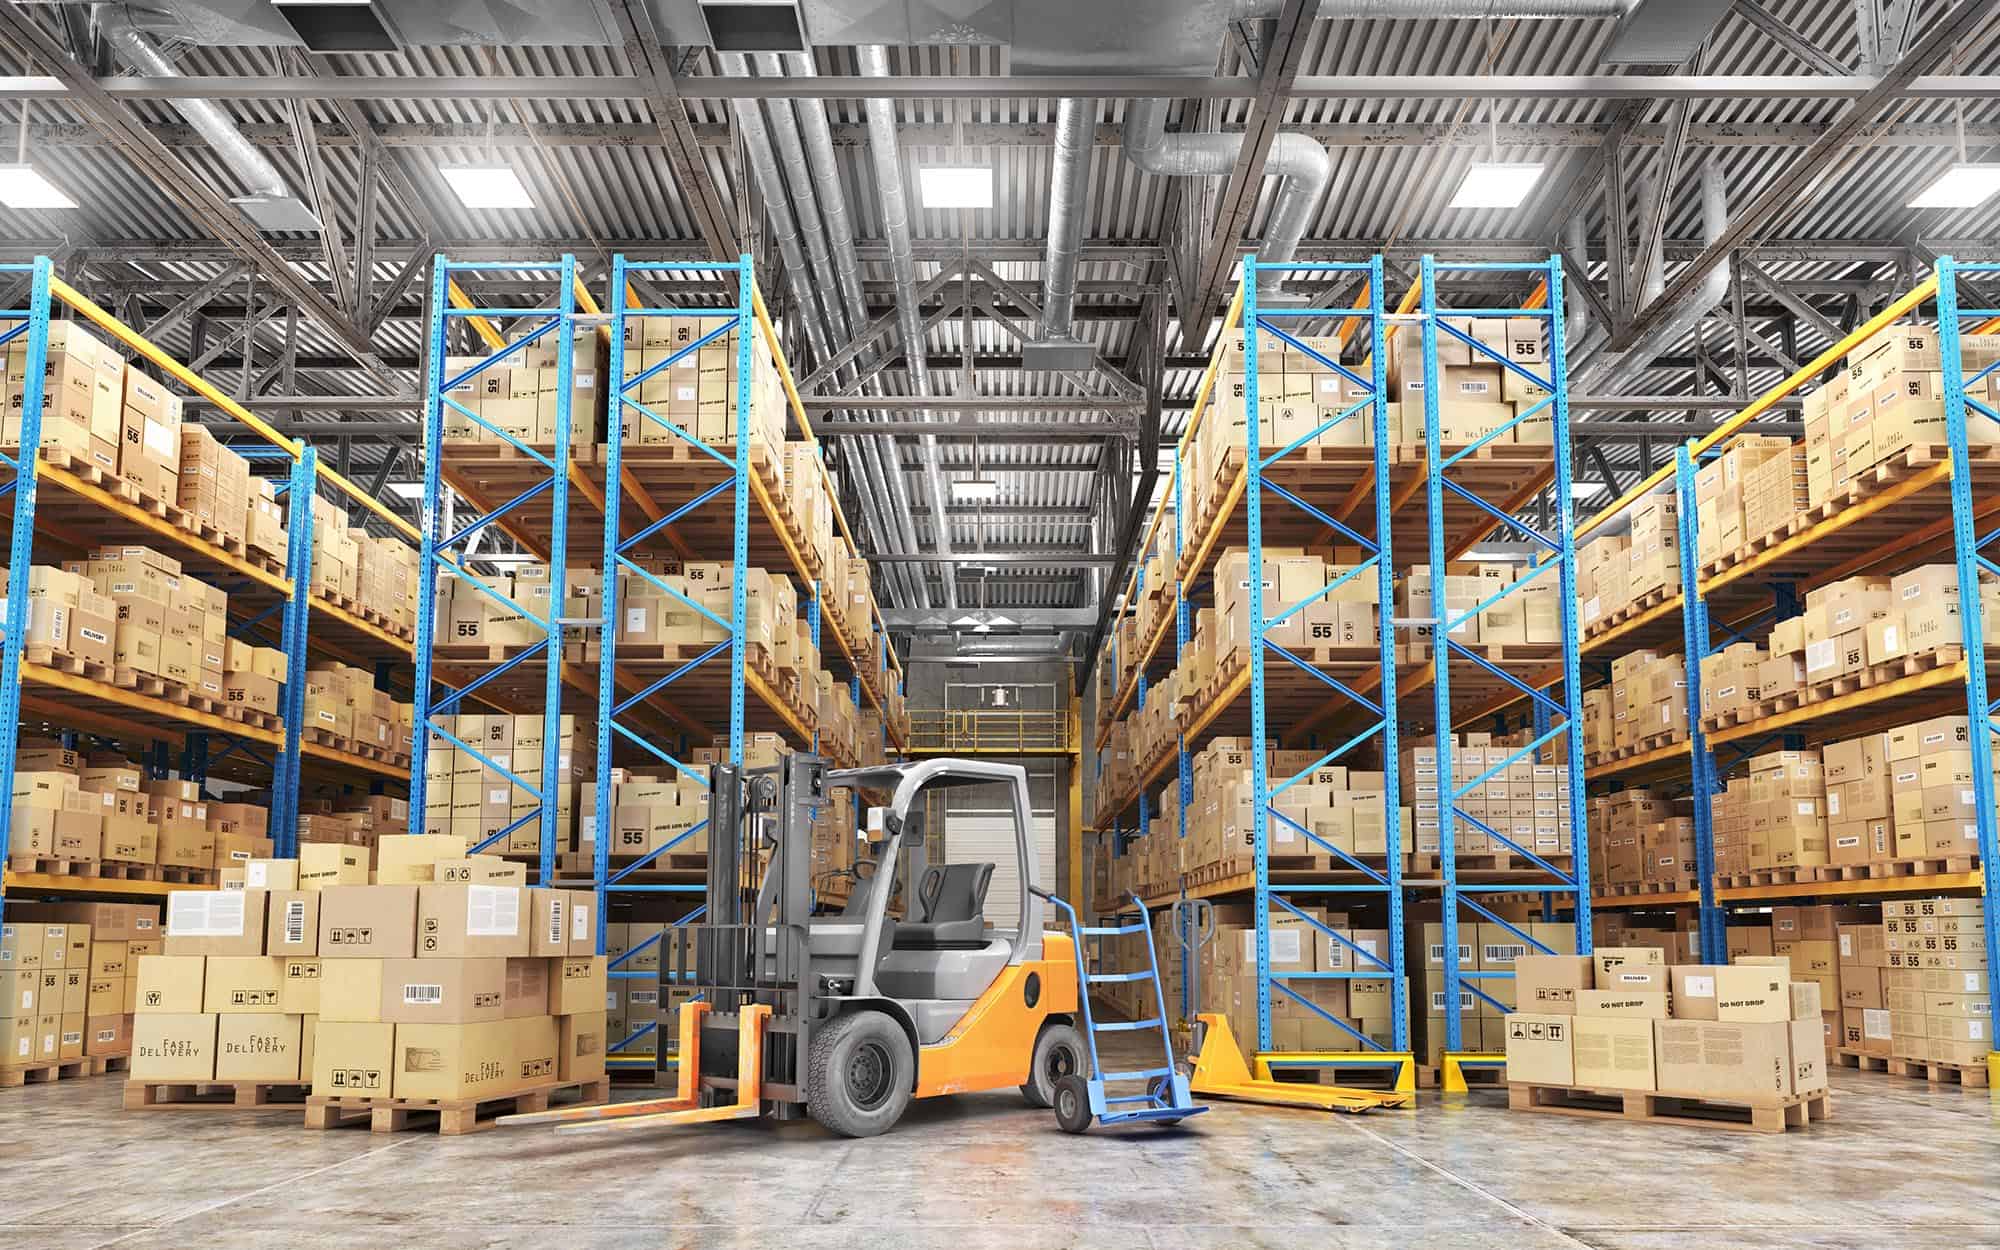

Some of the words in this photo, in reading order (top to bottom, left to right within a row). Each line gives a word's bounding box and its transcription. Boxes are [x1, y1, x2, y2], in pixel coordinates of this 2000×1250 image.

[1516, 343, 1535, 355] 55
[1909, 340, 1923, 349] 55
[1851, 368, 1863, 380] 55
[488, 379, 497, 393] 55
[1234, 384, 1243, 397] 55
[1909, 381, 1918, 396] 55
[127, 429, 139, 444] 55
[690, 571, 704, 580] 55
[458, 624, 478, 636] 55
[1312, 626, 1332, 638] 55
[83, 630, 104, 642] DELIVERY
[1848, 652, 1859, 664] 55
[228, 691, 244, 701] 55
[491, 725, 501, 739] 55
[1956, 727, 1965, 741] 55
[63, 754, 74, 765] 55
[1228, 755, 1242, 764] 55
[1319, 774, 1333, 783] 55
[623, 832, 643, 845] 55
[1904, 906, 1915, 915] 55
[1922, 904, 1934, 915] 55
[1888, 923, 1898, 932] 55
[1905, 922, 1917, 933] 55
[1926, 940, 1937, 949] 55
[1945, 939, 1957, 950] 55
[1891, 956, 1901, 965] 55
[1908, 956, 1920, 966] 55
[45, 977, 55, 986] 55
[68, 976, 79, 985] 55
[250, 1035, 278, 1046] FAST
[1848, 1030, 1860, 1042] 55
[163, 1039, 191, 1049] FAST
[226, 1042, 287, 1053] DELIVERY
[140, 1046, 200, 1057] DELIVERY
[480, 1062, 500, 1072] FAST
[465, 1070, 505, 1083] DELIVERY
